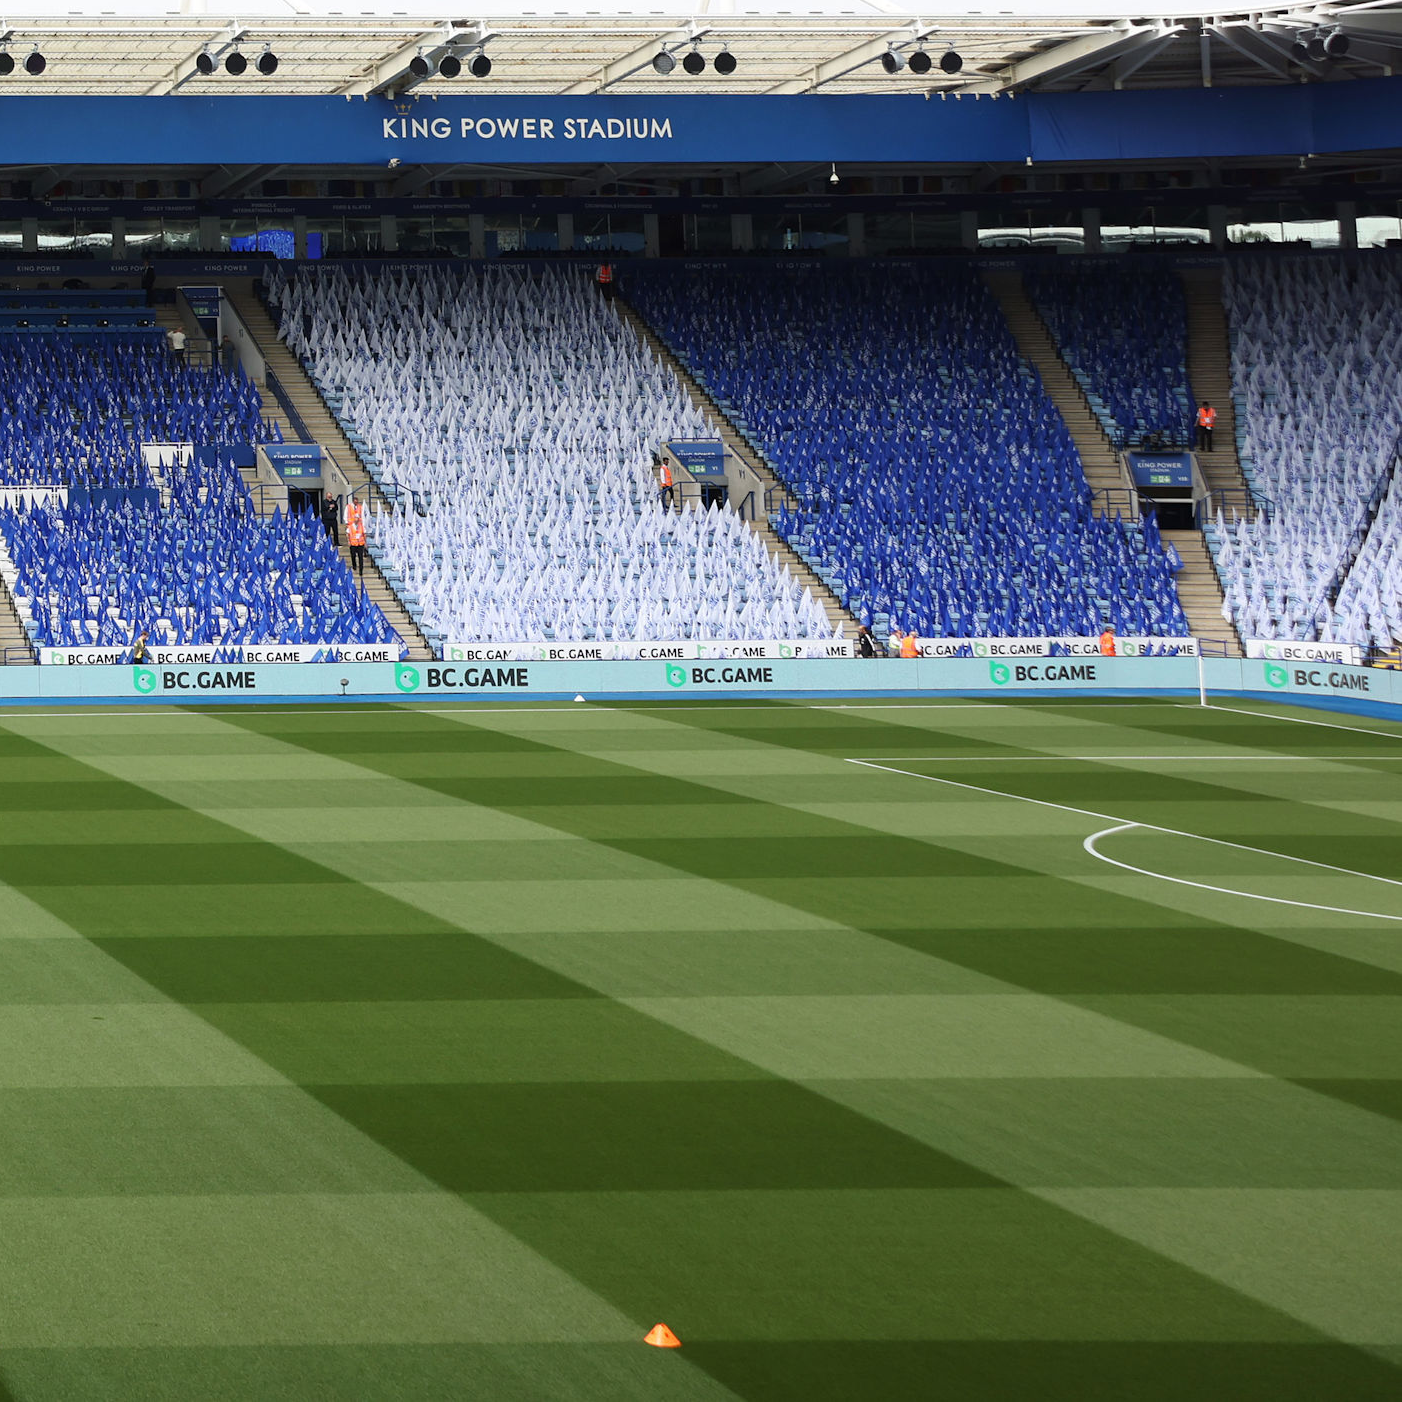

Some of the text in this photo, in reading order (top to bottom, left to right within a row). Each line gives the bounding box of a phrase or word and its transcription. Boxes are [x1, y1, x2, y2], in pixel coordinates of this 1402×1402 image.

[383, 118, 673, 139] KING POWER STADIUM
[549, 649, 602, 659] BC.GAME
[639, 648, 684, 658] C.GAME
[990, 645, 1043, 655] BC.GAME
[1065, 645, 1101, 655] BC.GA
[1284, 648, 1343, 660] BC.GAME
[158, 653, 211, 664] BC.GAME
[247, 652, 300, 662] BC.GAME
[338, 651, 389, 662] BC.GAME
[427, 668, 529, 688] BC.GAME
[692, 667, 773, 684] BC.GAME
[1015, 665, 1096, 681] BC.GAME
[162, 671, 255, 689] BC.GAME
[1294, 668, 1370, 692] BC.GAME
